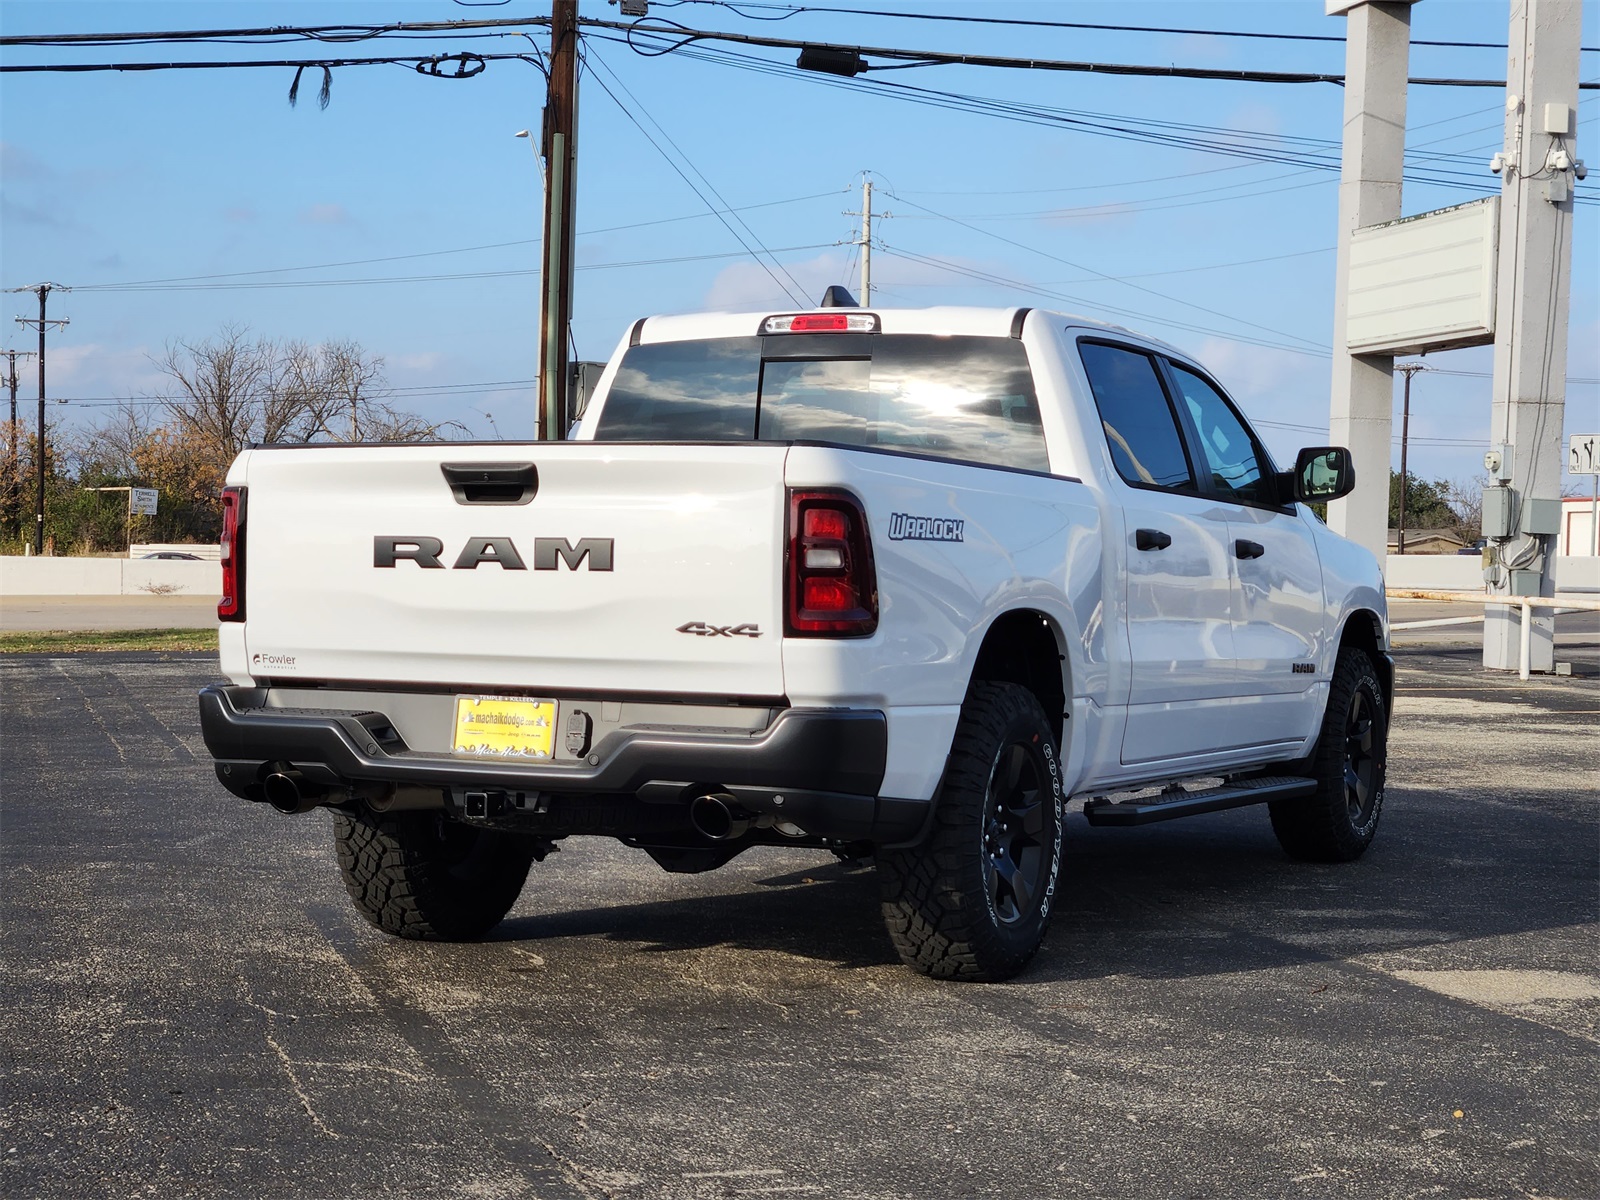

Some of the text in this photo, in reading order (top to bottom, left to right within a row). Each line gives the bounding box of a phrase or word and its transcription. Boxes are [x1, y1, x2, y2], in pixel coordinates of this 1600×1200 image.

[888, 512, 965, 542] WARLOCK
[373, 535, 615, 572] RAM
[675, 621, 764, 638] 4x4
[262, 654, 296, 664] Fowler
[1292, 662, 1316, 674] RAM
[475, 712, 535, 728] machaikdodge.com
[473, 743, 499, 756] Mac
[1040, 743, 1062, 918] GOODYEAR
